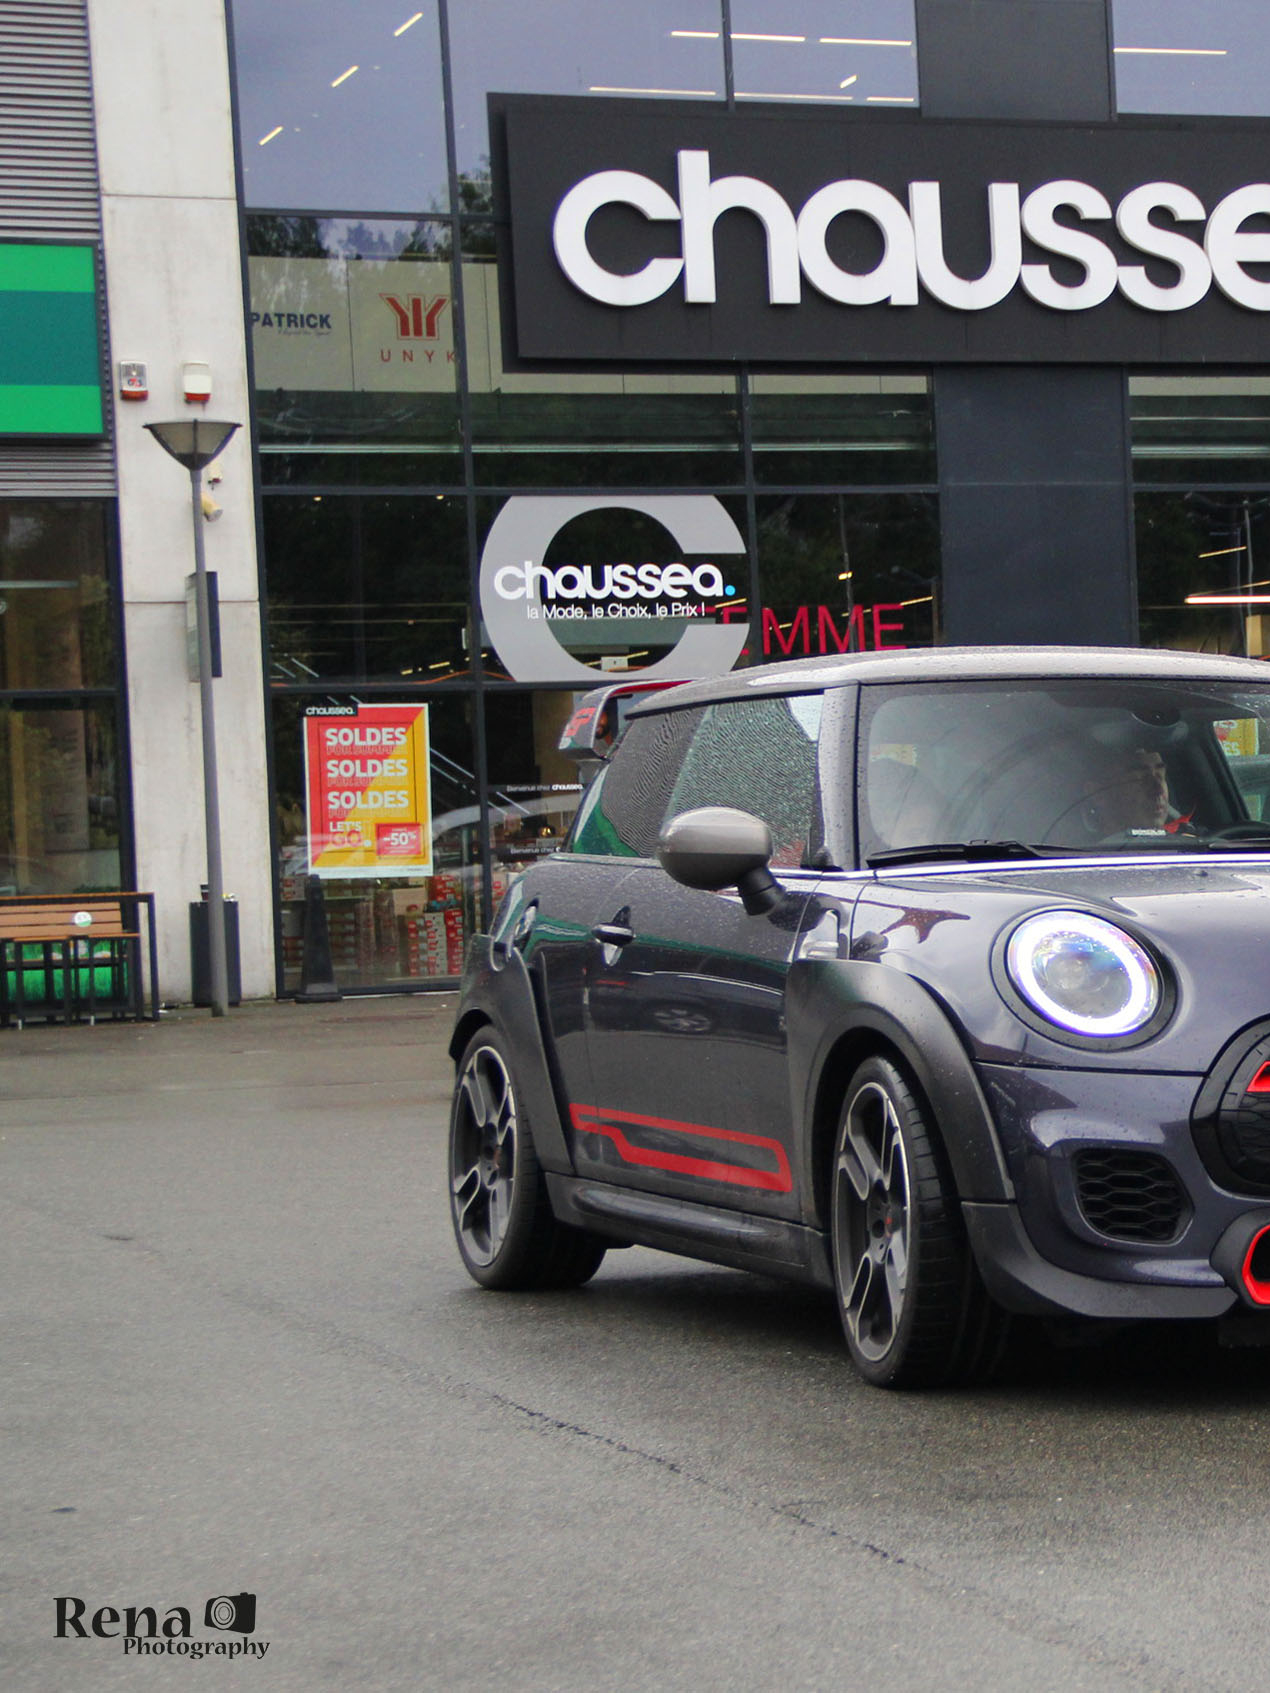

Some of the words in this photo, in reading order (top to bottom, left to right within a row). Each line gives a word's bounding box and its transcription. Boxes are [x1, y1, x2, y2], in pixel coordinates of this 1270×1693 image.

[251, 313, 332, 329] PATRICK
[527, 604, 539, 619] la
[543, 604, 588, 620] Mode,
[592, 604, 604, 618] le
[607, 603, 651, 619] Choix,
[656, 602, 668, 616] le
[672, 602, 697, 616] Prix
[325, 728, 407, 746] SOLDES
[326, 759, 408, 778] SOLDES
[328, 790, 410, 809] SOLDES
[329, 821, 362, 832] LET'S
